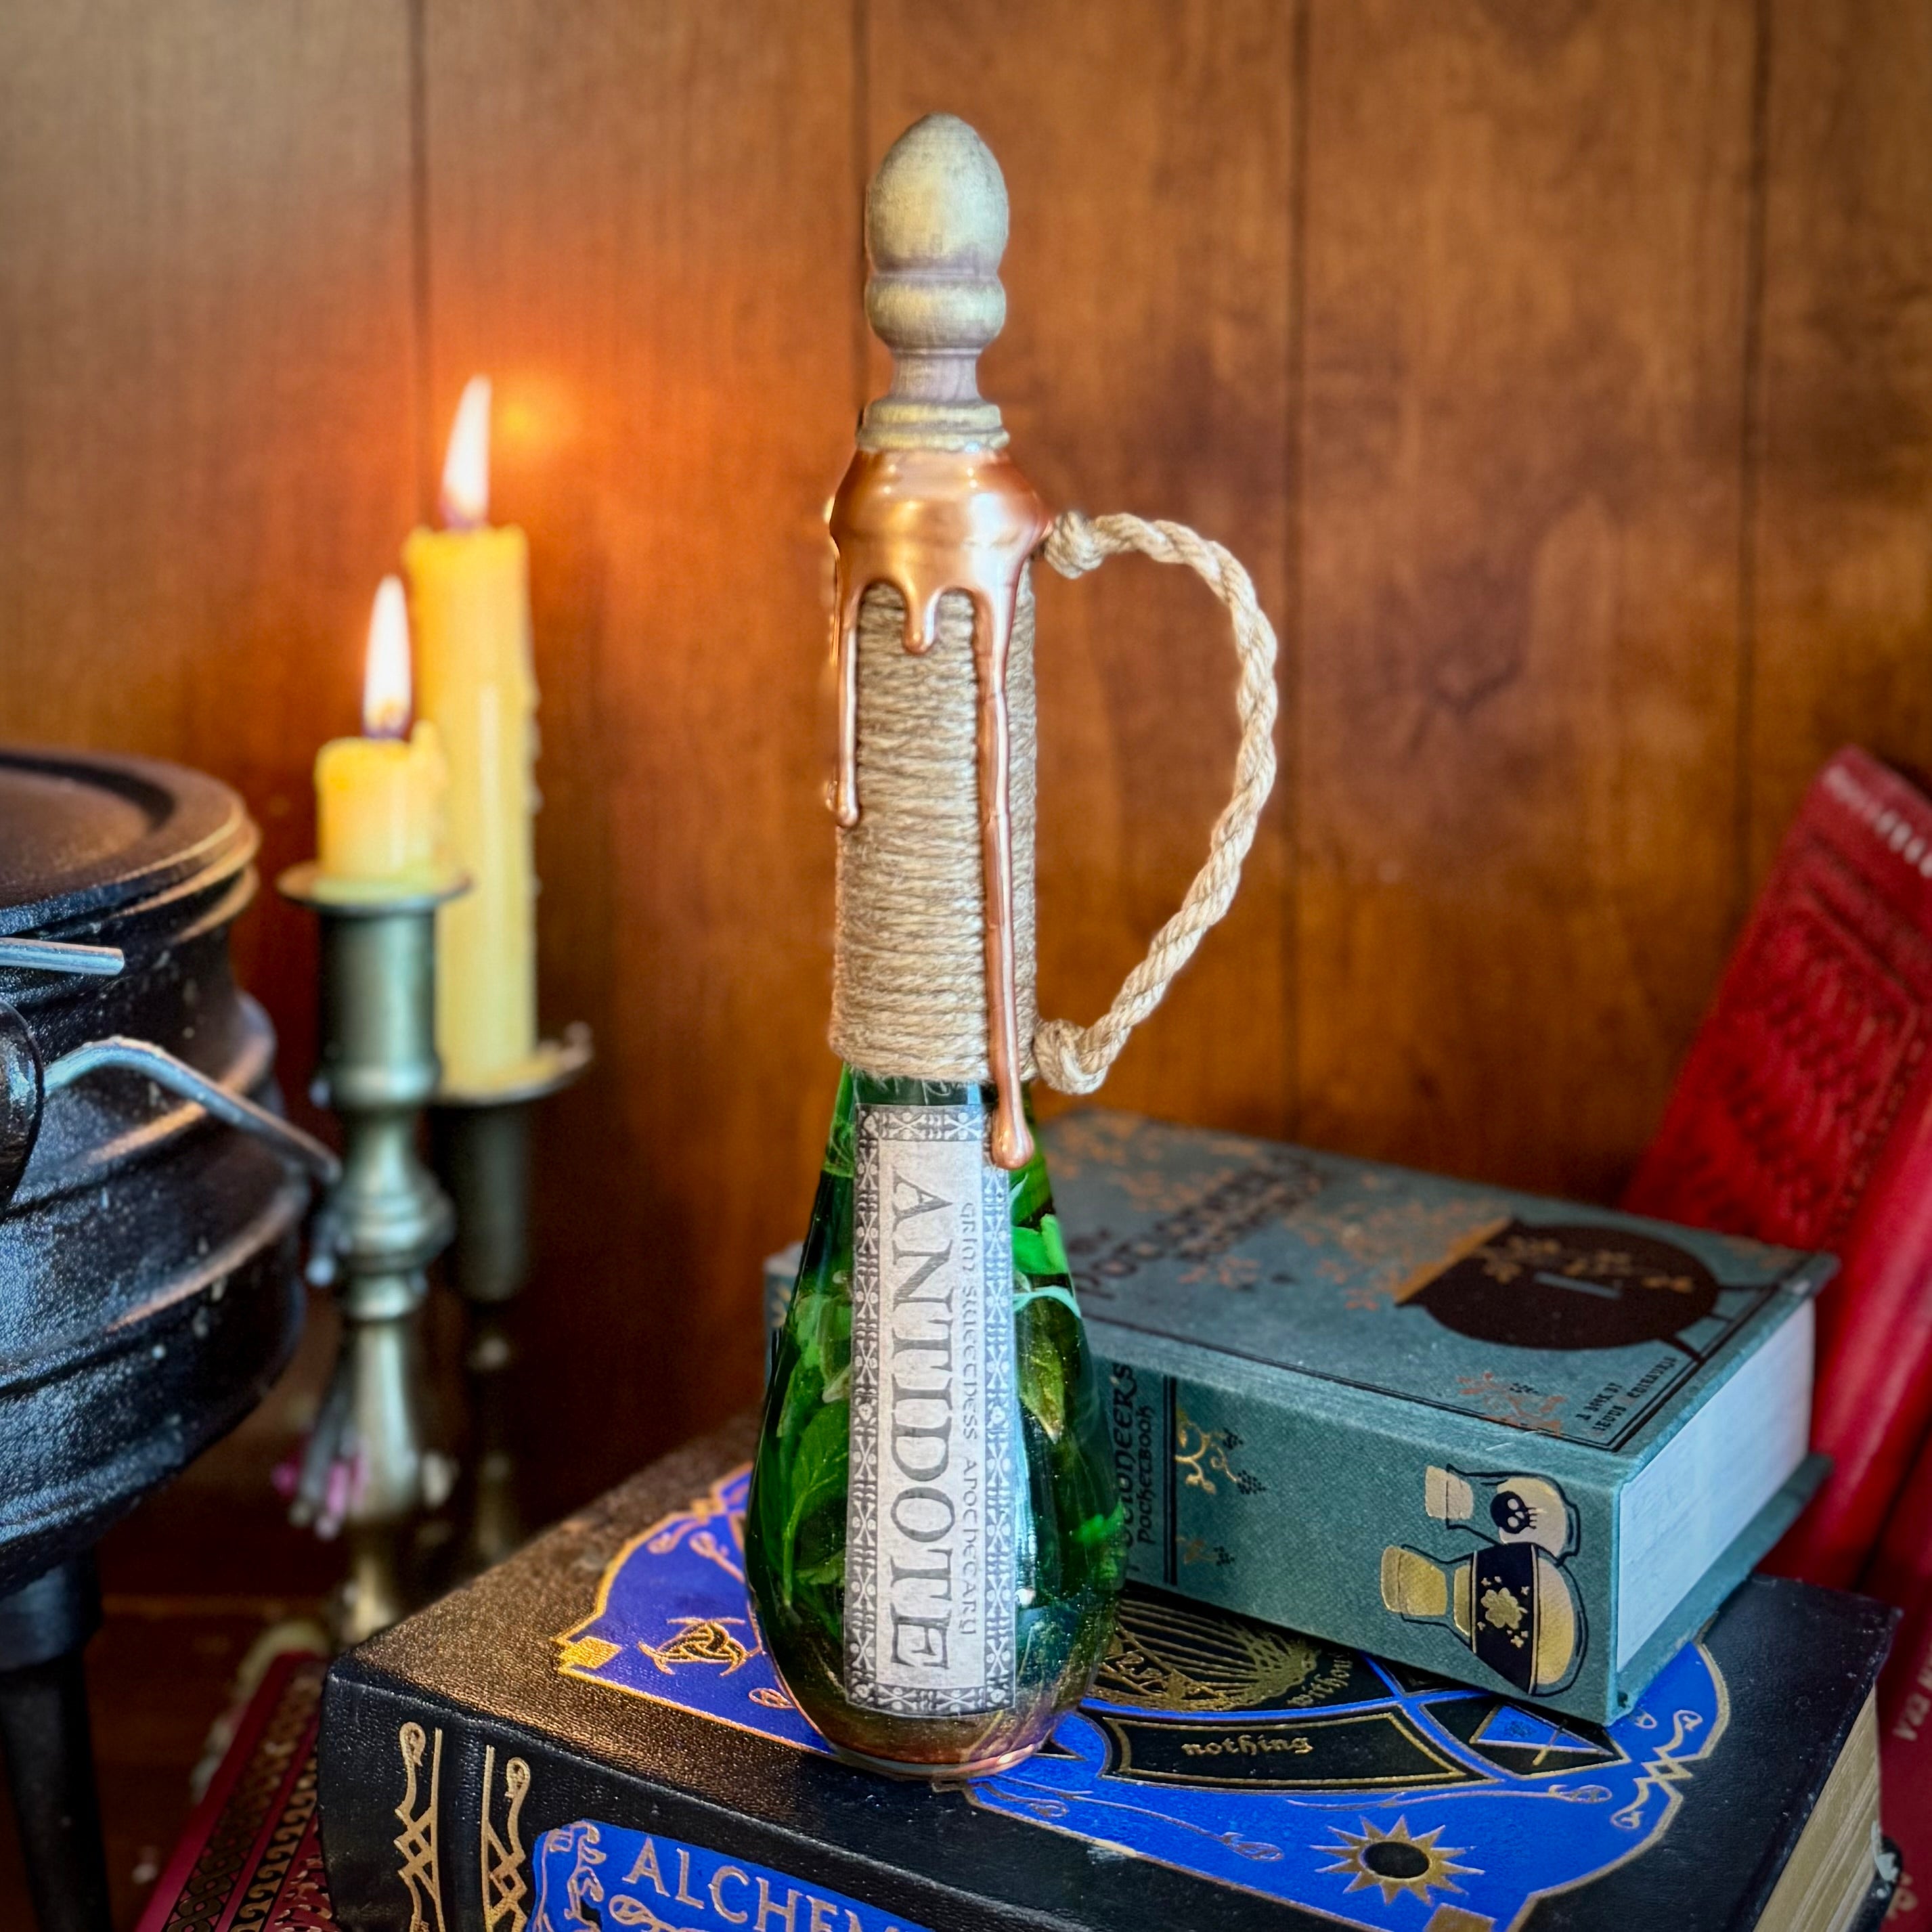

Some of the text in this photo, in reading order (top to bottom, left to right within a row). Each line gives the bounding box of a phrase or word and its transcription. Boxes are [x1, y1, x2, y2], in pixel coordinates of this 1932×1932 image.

[959, 1202, 978, 1271] GRIM
[890, 1170, 955, 1669] ANTIDOTE
[1181, 1734, 1313, 1756] nothing
